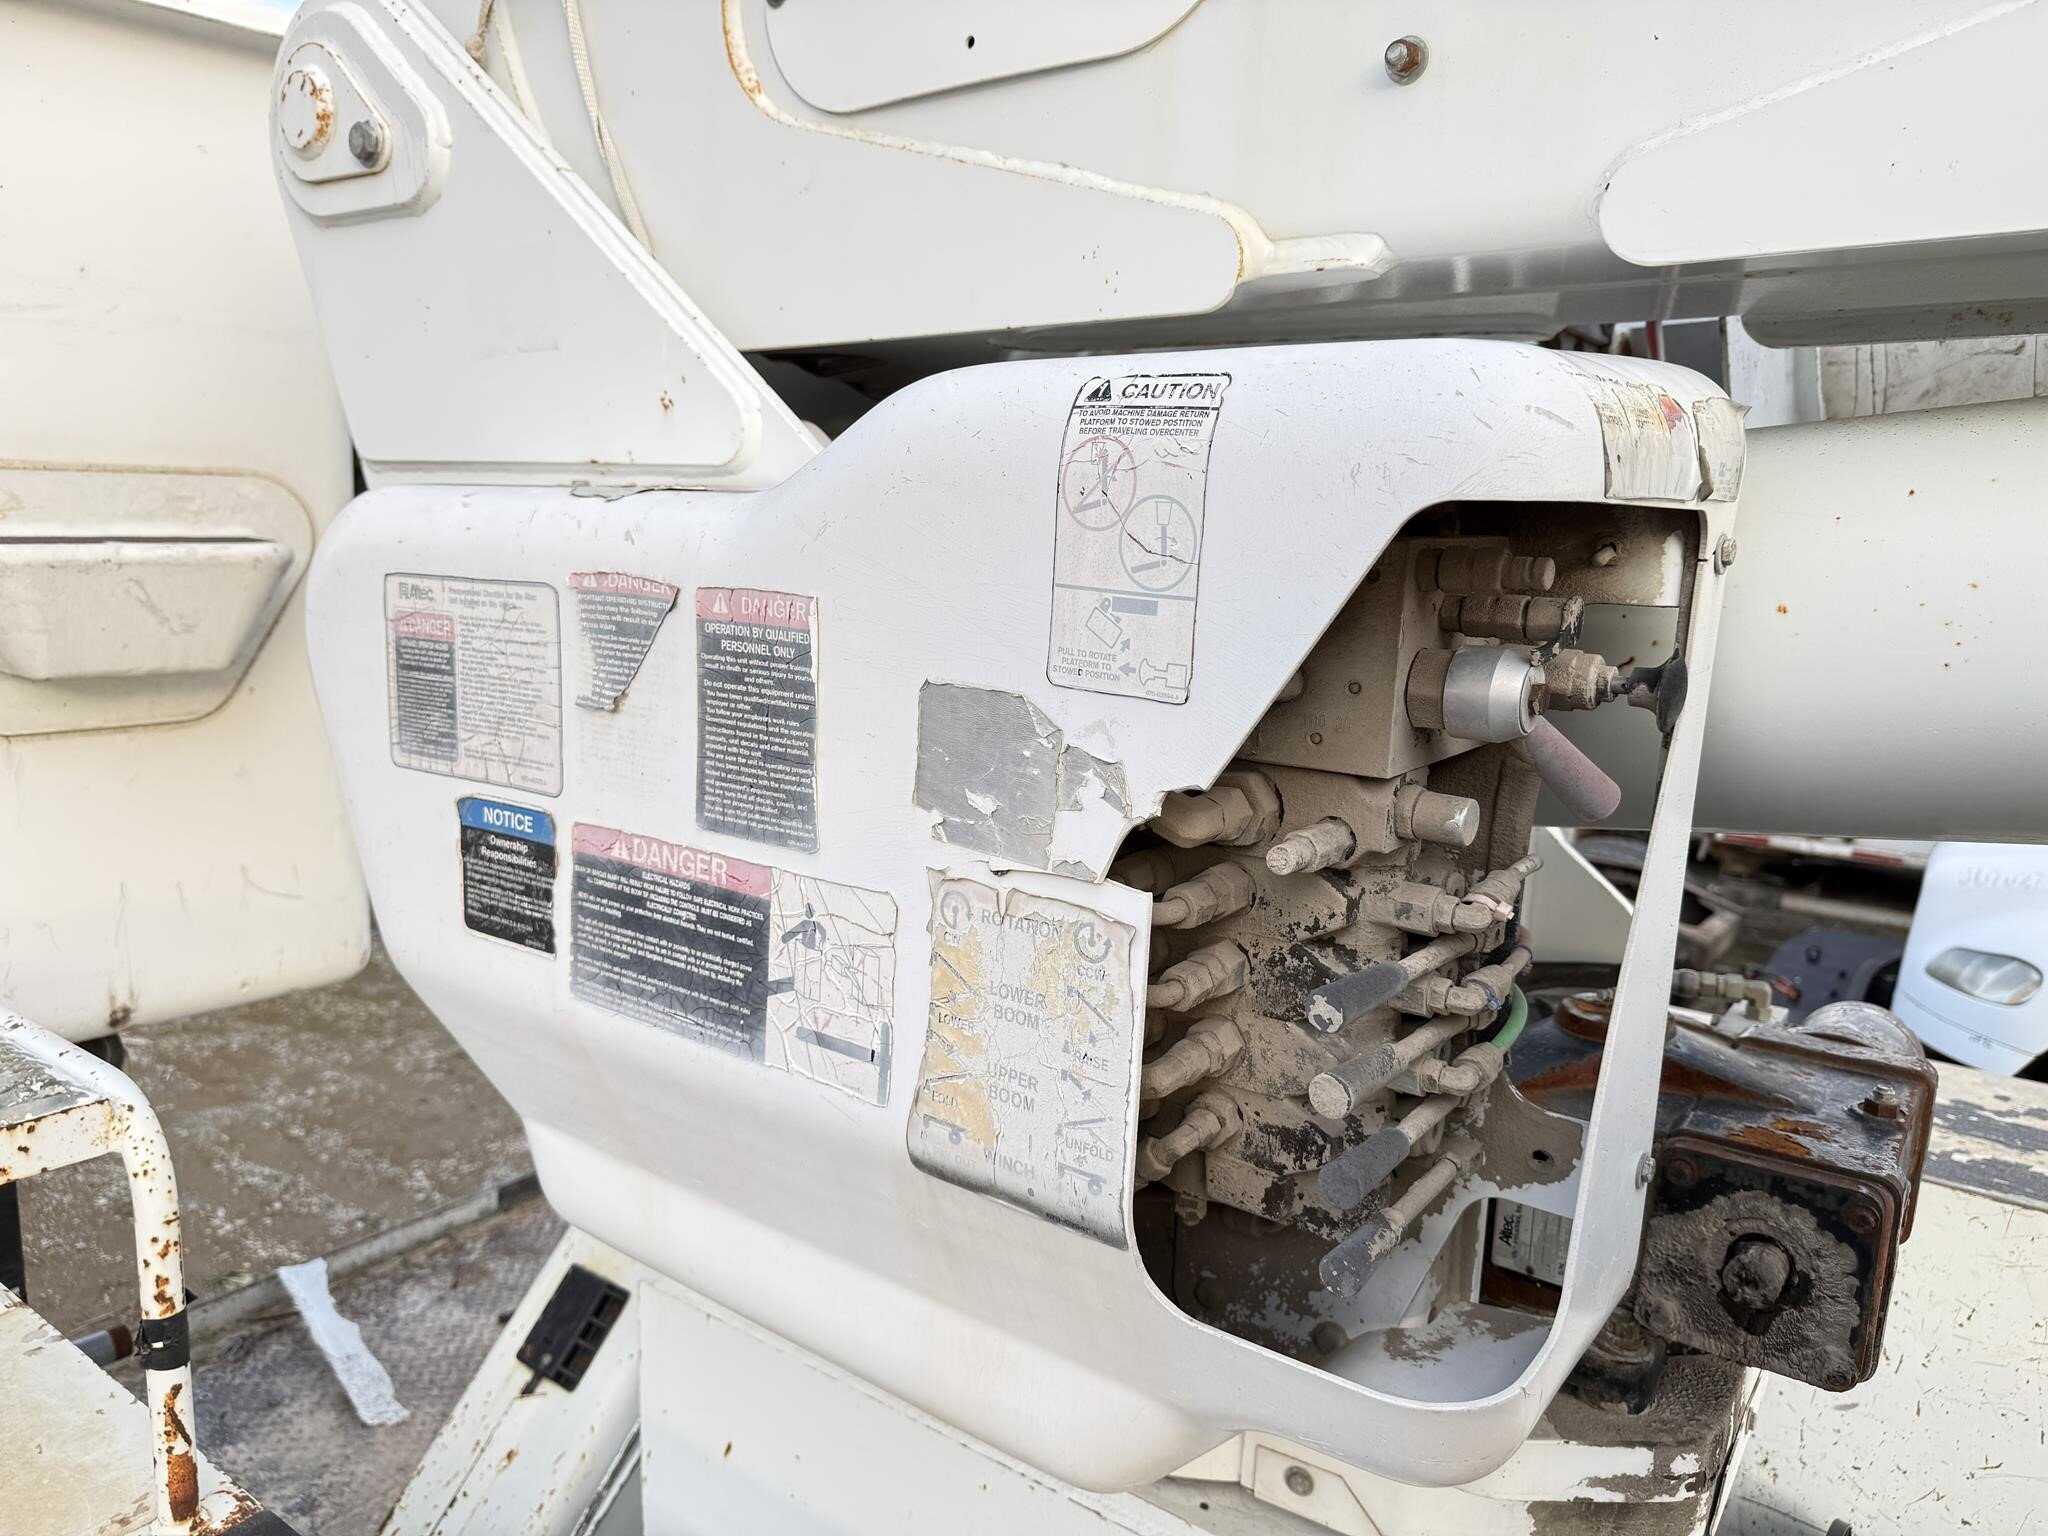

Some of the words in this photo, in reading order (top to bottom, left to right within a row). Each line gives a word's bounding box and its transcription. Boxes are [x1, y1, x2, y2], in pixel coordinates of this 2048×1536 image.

[1122, 383, 1221, 400] CAUTION
[1078, 409, 1088, 417] TO
[1089, 409, 1111, 417] AVOID
[1112, 409, 1145, 418] MACHINE
[1147, 410, 1178, 419] DAMAGE
[1179, 410, 1210, 419] RETURN
[1080, 417, 1116, 426] PLATFORM
[1117, 418, 1128, 426] TO
[1129, 418, 1161, 427] STOWED
[1162, 419, 1203, 428] POSTITION
[1079, 427, 1107, 435] BEFORE
[1108, 427, 1148, 436] TRAVELING
[1149, 428, 1199, 437] OVERCENTER
[608, 574, 673, 594] DANGER
[741, 596, 807, 621] DANGER
[704, 622, 750, 637] OPERATION
[752, 628, 764, 639] BY
[765, 629, 810, 644] QUALIFIED
[721, 640, 771, 656] PERSONNEL
[773, 646, 796, 658] ONLY
[1058, 646, 1075, 656] PULL
[1077, 648, 1087, 658] TO
[1088, 650, 1118, 661] ROTATE
[1062, 657, 1100, 670] PLATFORM
[1101, 661, 1112, 671] TO
[1084, 670, 1120, 681] POSITION
[723, 683, 747, 691] operate
[761, 688, 794, 698] equipment
[795, 692, 815, 701] unless
[484, 806, 534, 833] NOTICE
[490, 834, 529, 854] Ownership
[481, 846, 538, 869] Responsibilities
[630, 838, 728, 886] DANGER
[990, 980, 1048, 1010] LOWER
[938, 1012, 975, 1031] LOWER
[993, 1004, 1040, 1030] BOOM
[988, 1062, 1039, 1092] UPPER
[988, 1085, 1035, 1112] BOOM
[1065, 1135, 1113, 1161] UNFOLD
